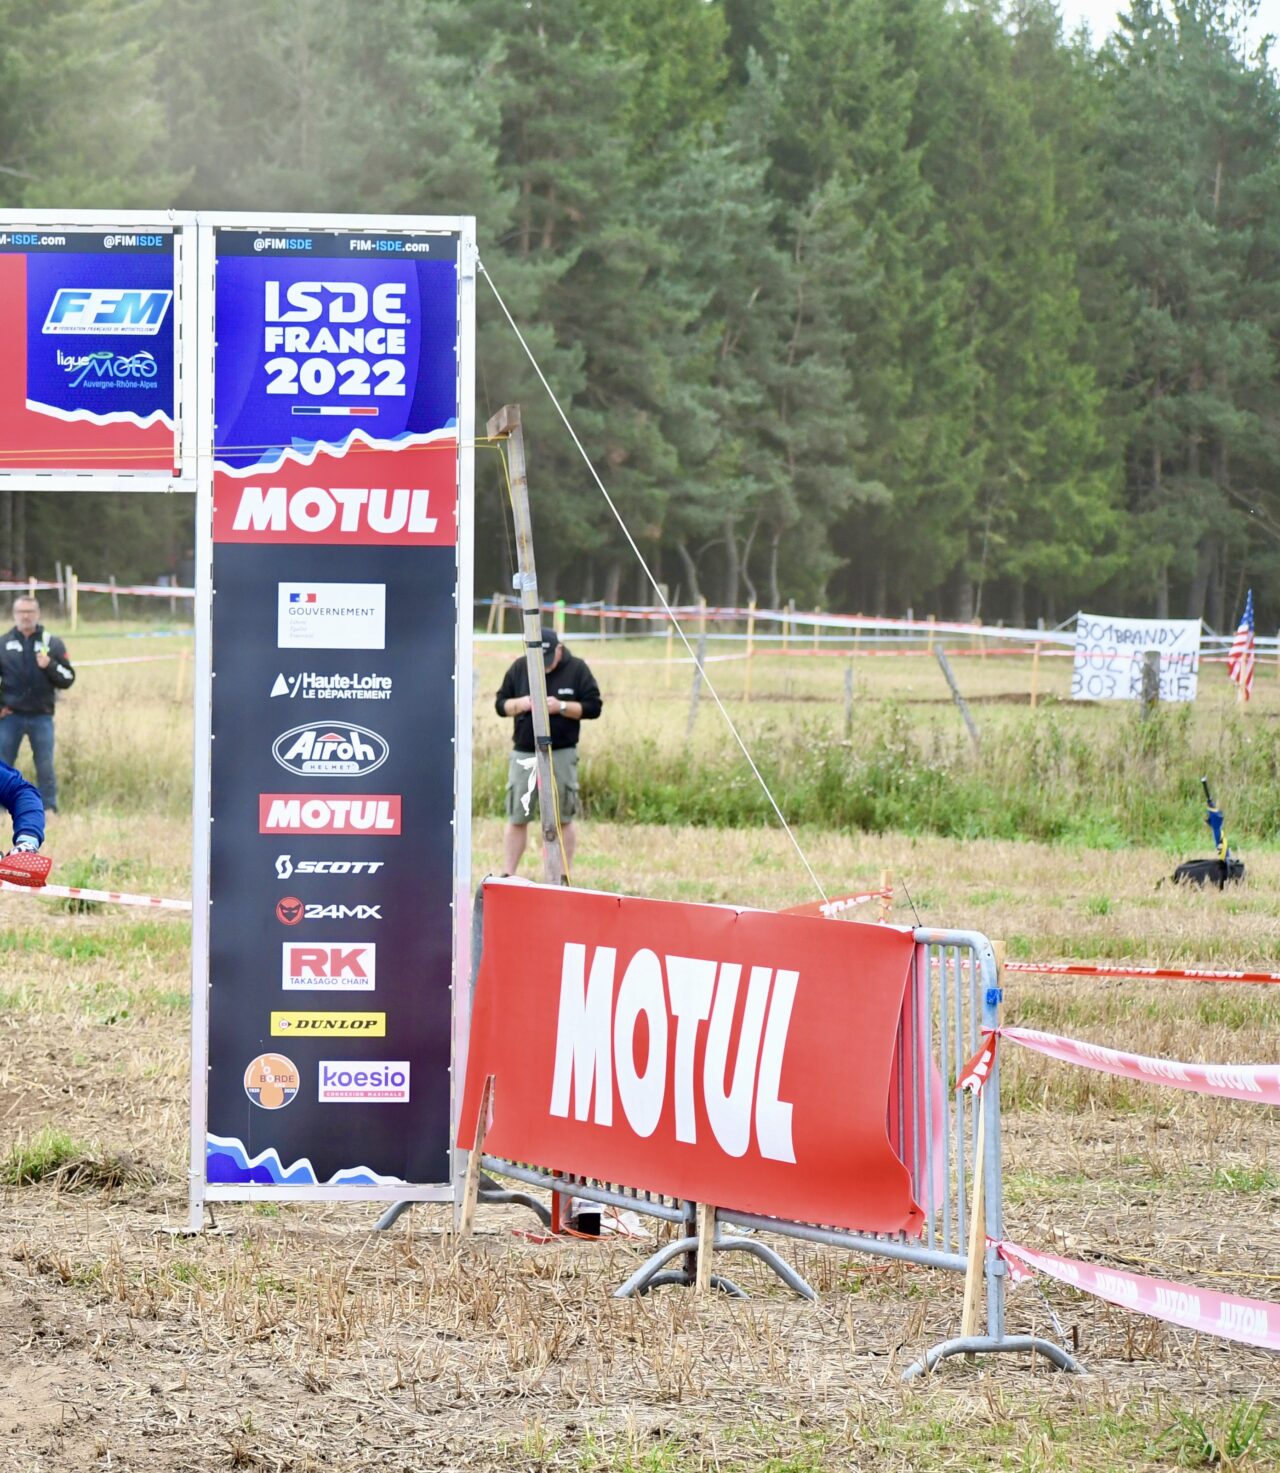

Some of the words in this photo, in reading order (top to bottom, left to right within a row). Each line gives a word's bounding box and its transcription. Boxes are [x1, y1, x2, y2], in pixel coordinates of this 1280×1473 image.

[103, 234, 163, 248] @FIMISDE
[253, 238, 312, 251] @FIMISDE
[349, 239, 429, 252] FIM-ISDE.com
[49, 291, 169, 325] FFM
[264, 281, 407, 324] ISDE
[264, 326, 406, 355] FRANCE
[56, 349, 90, 372] ligue
[83, 380, 158, 389] Auvergne-Rhône-Alpes
[264, 357, 406, 396] 2022
[232, 486, 438, 534] MOTUL
[288, 606, 375, 617] GOUVERNEMENT
[303, 671, 392, 689] Haute-Loire
[302, 688, 316, 699] LE
[265, 799, 395, 829] MOTUL
[294, 861, 384, 874] SCOTT
[303, 904, 383, 919] 24MX
[289, 948, 368, 977] RK
[290, 977, 338, 985] TAKASAGO
[341, 978, 369, 986] CHAIN
[295, 1019, 378, 1030] DUNLOP
[549, 942, 800, 1164] MOTUL
[259, 1074, 295, 1083] BORDE
[323, 1065, 406, 1087] koesio
